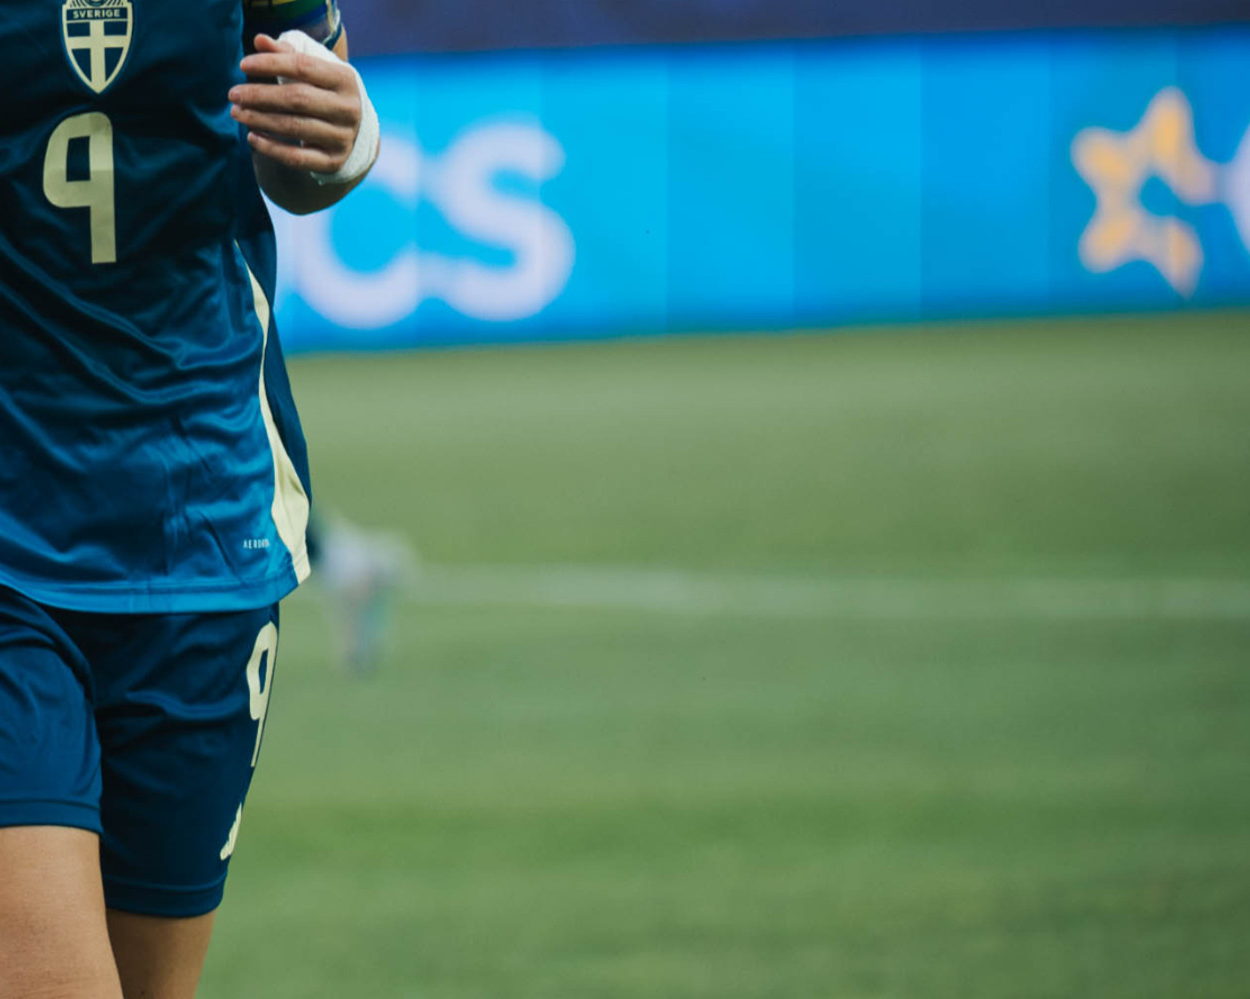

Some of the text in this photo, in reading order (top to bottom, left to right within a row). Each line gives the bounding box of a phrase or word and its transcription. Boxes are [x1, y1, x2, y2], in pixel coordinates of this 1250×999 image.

[72, 9, 121, 19] SVERIGE
[42, 111, 117, 264] 9
[246, 621, 278, 768] 9
